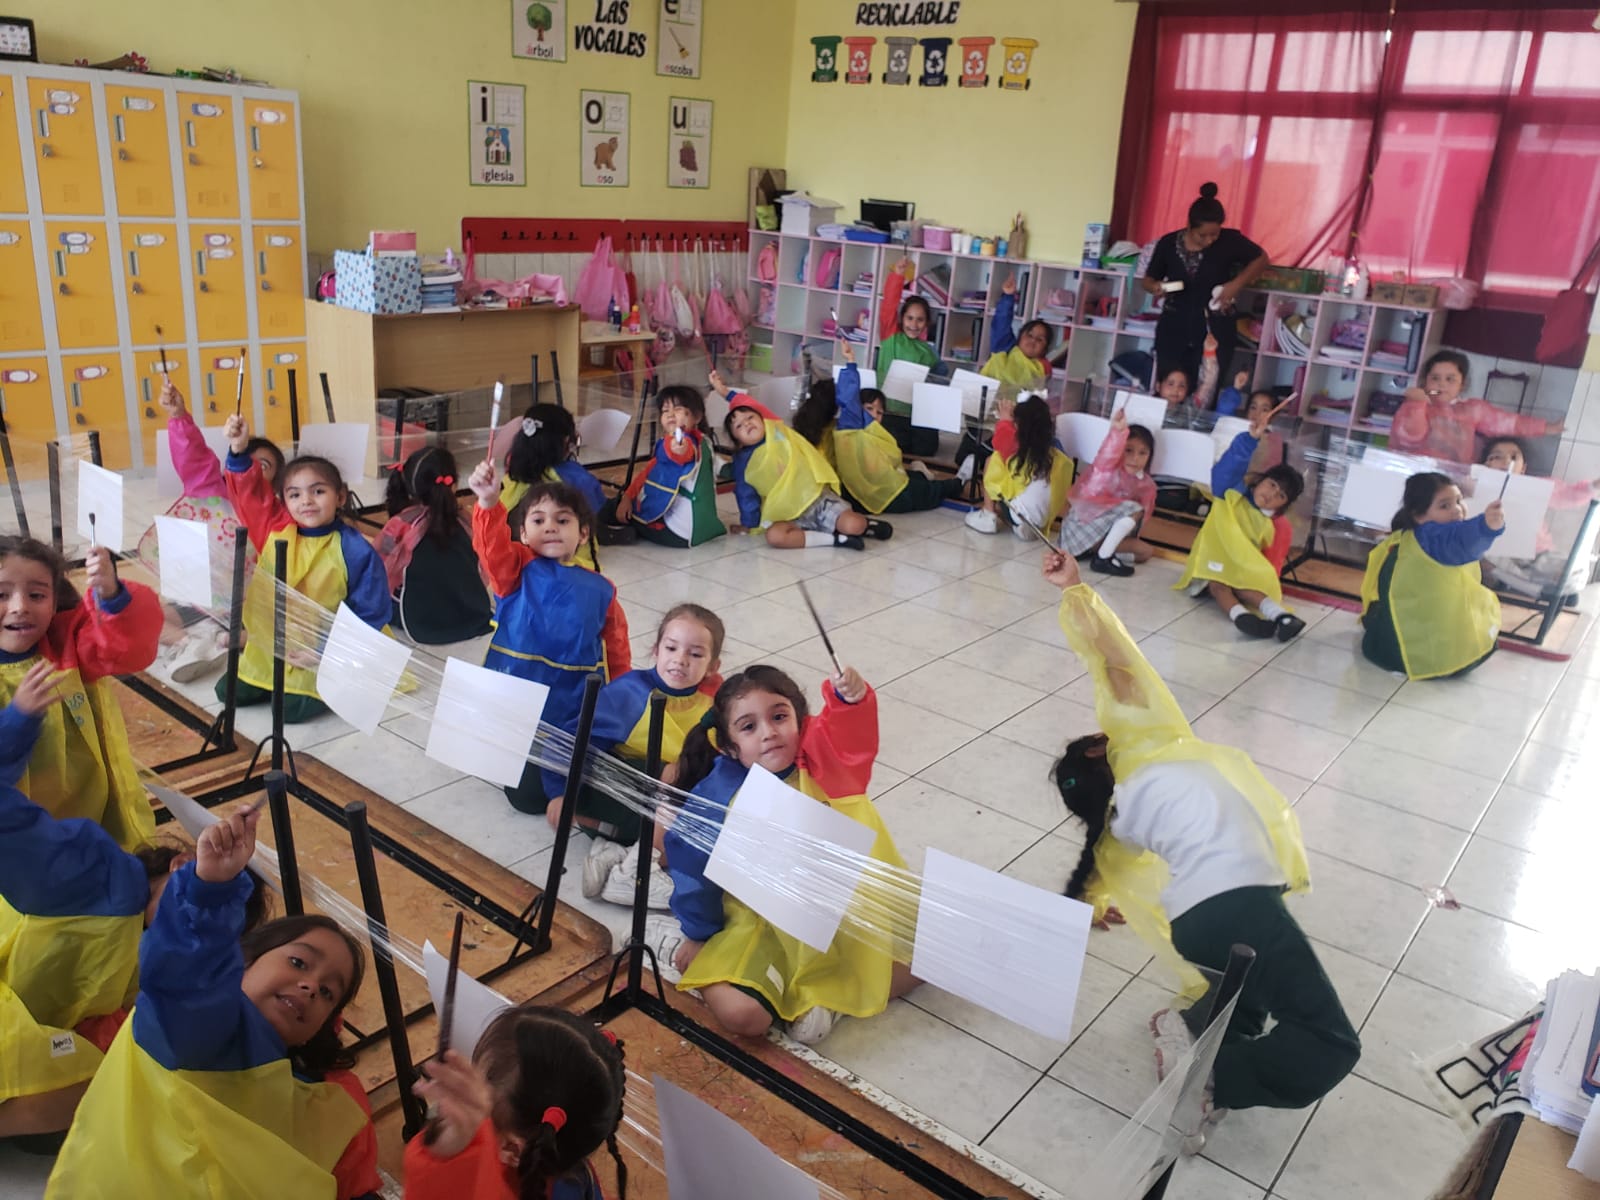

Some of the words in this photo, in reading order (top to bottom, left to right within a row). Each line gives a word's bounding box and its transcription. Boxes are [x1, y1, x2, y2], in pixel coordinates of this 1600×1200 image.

[595, 0, 629, 25] LAS
[856, 2, 959, 26] RECICLABLE
[575, 25, 647, 58] VOCALES
[480, 86, 489, 123] i
[673, 106, 687, 130] u
[481, 167, 515, 183] iglesia
